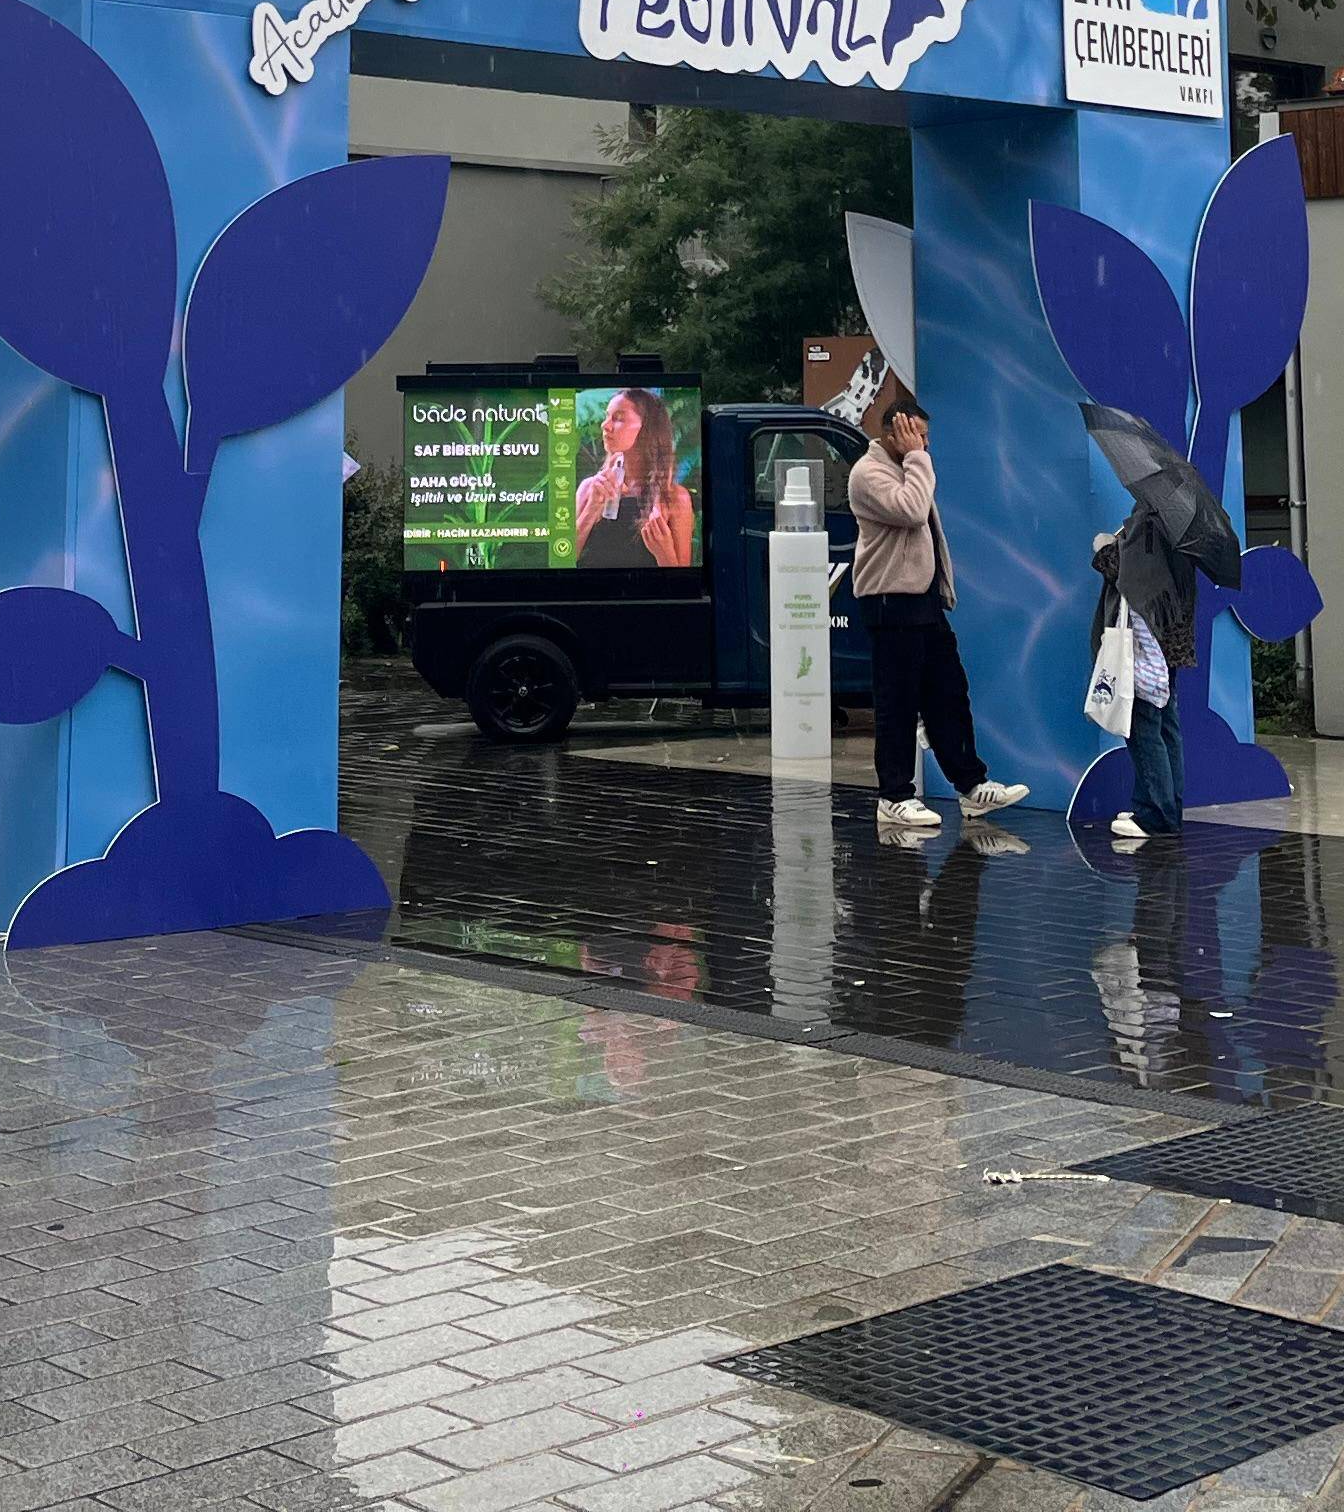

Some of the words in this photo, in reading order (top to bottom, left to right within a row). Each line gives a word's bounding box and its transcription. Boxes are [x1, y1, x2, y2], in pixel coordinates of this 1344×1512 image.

[1073, 18, 1212, 78] ÇEMBERLERİ
[1179, 85, 1214, 106] VAKFI
[472, 403, 545, 422] natural
[414, 444, 441, 457] SAF
[442, 442, 501, 457] BİBERİYE
[502, 444, 540, 456] SUYU
[410, 476, 448, 488] DAHA
